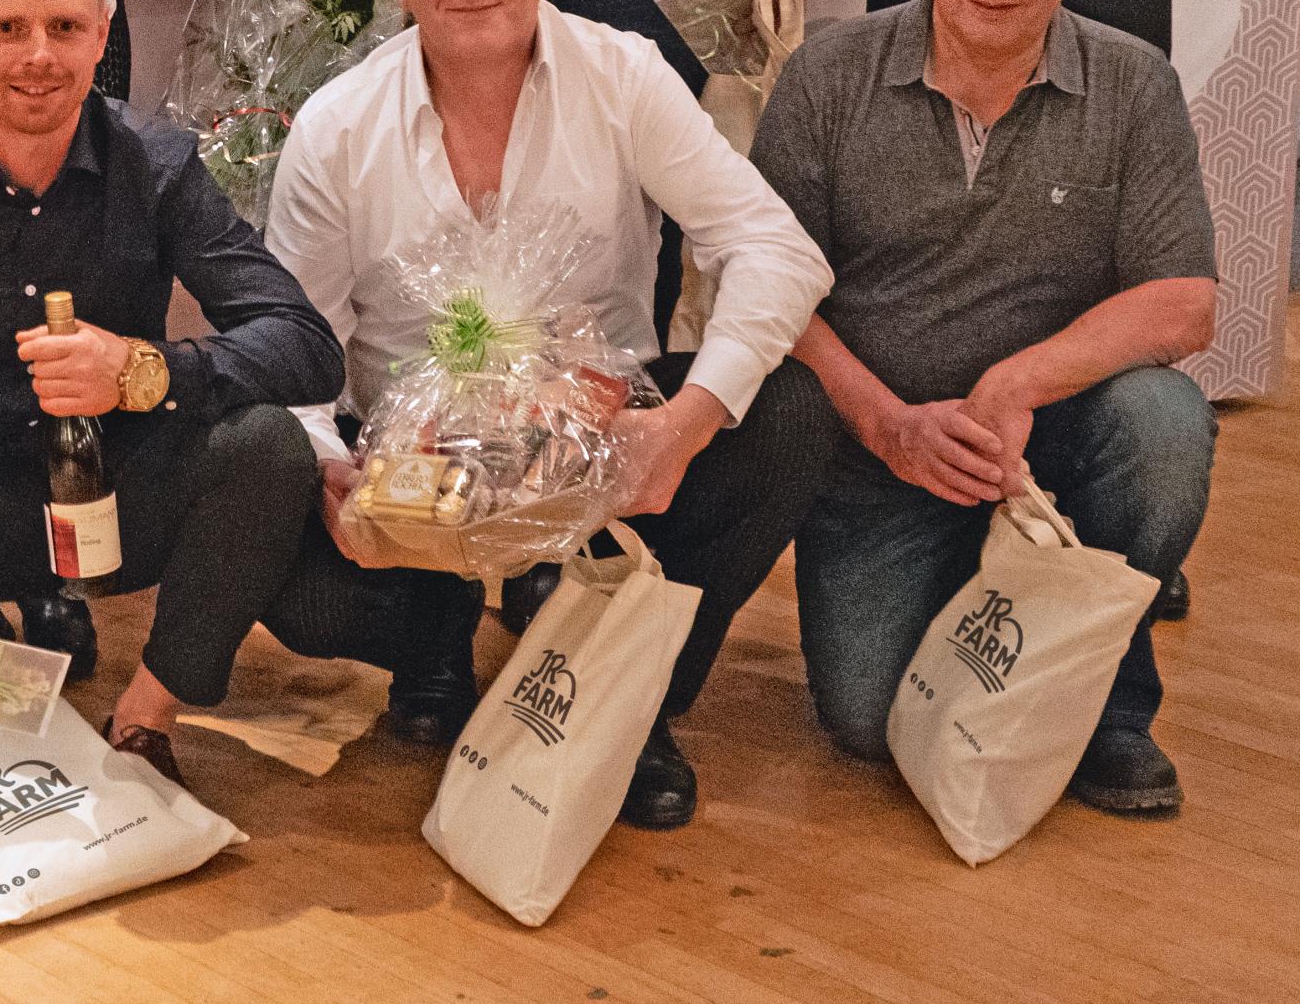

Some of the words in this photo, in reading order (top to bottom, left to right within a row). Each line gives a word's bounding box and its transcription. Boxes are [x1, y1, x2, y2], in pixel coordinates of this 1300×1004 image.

[972, 590, 1013, 632] JR
[954, 614, 1019, 678] FARM
[530, 650, 567, 685] JR
[512, 675, 573, 726] FARM
[510, 782, 549, 817] www.jr-farm.de
[83, 816, 149, 851] www.jr-farm.de
